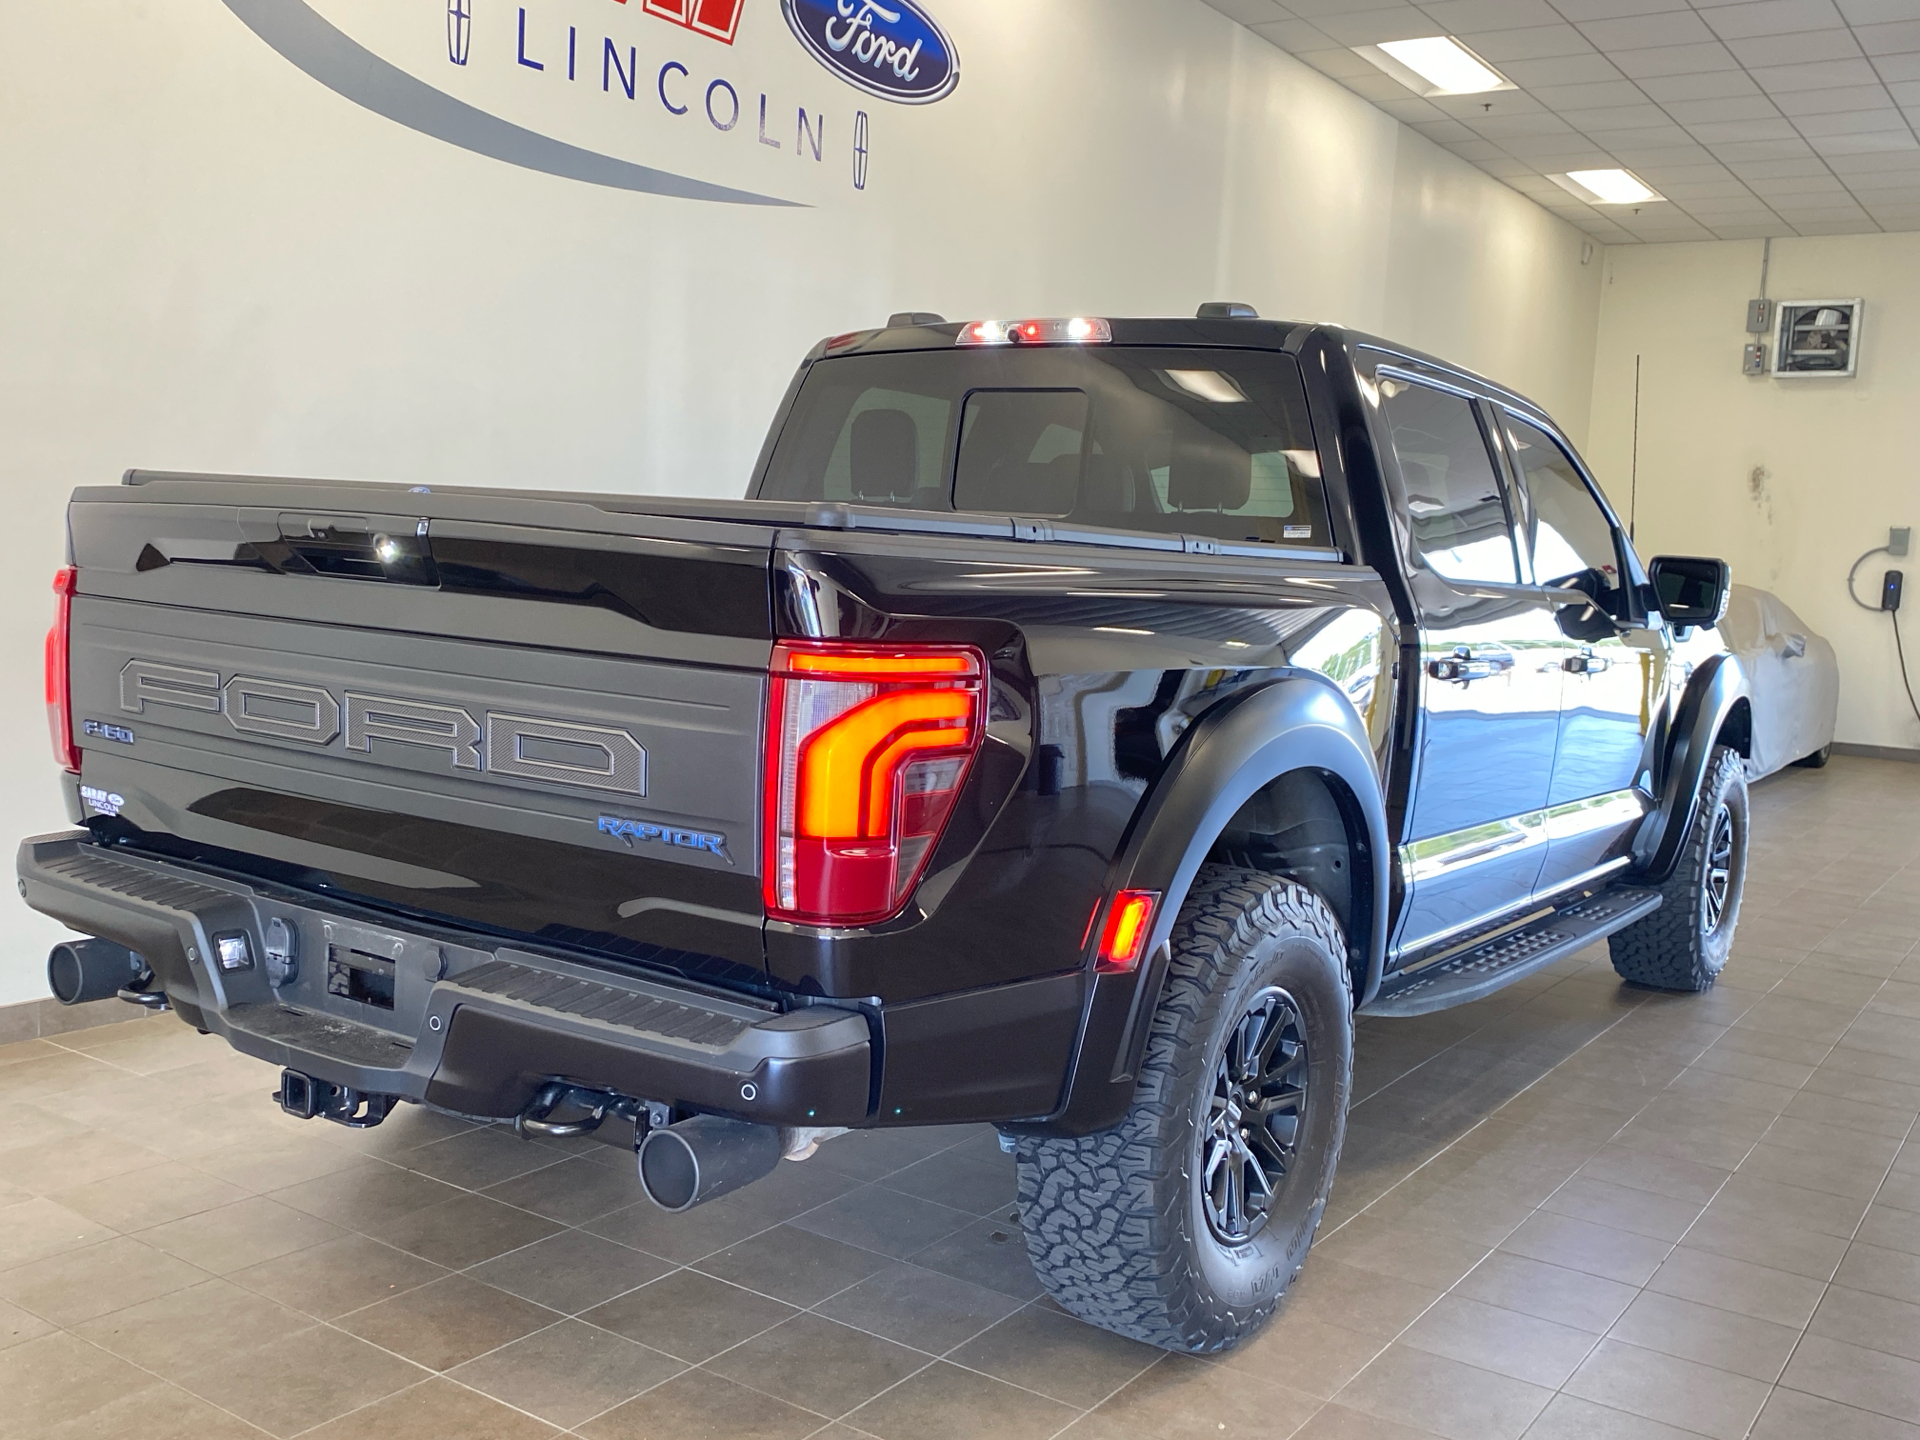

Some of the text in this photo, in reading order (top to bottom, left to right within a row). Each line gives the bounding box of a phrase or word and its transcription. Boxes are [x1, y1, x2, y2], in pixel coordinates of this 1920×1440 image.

[825, 0, 922, 82] Ford
[516, 7, 824, 163] LINCOLN
[119, 657, 647, 798] FORD
[88, 798, 119, 813] LINCOLN
[597, 814, 735, 866] RAPTOR
